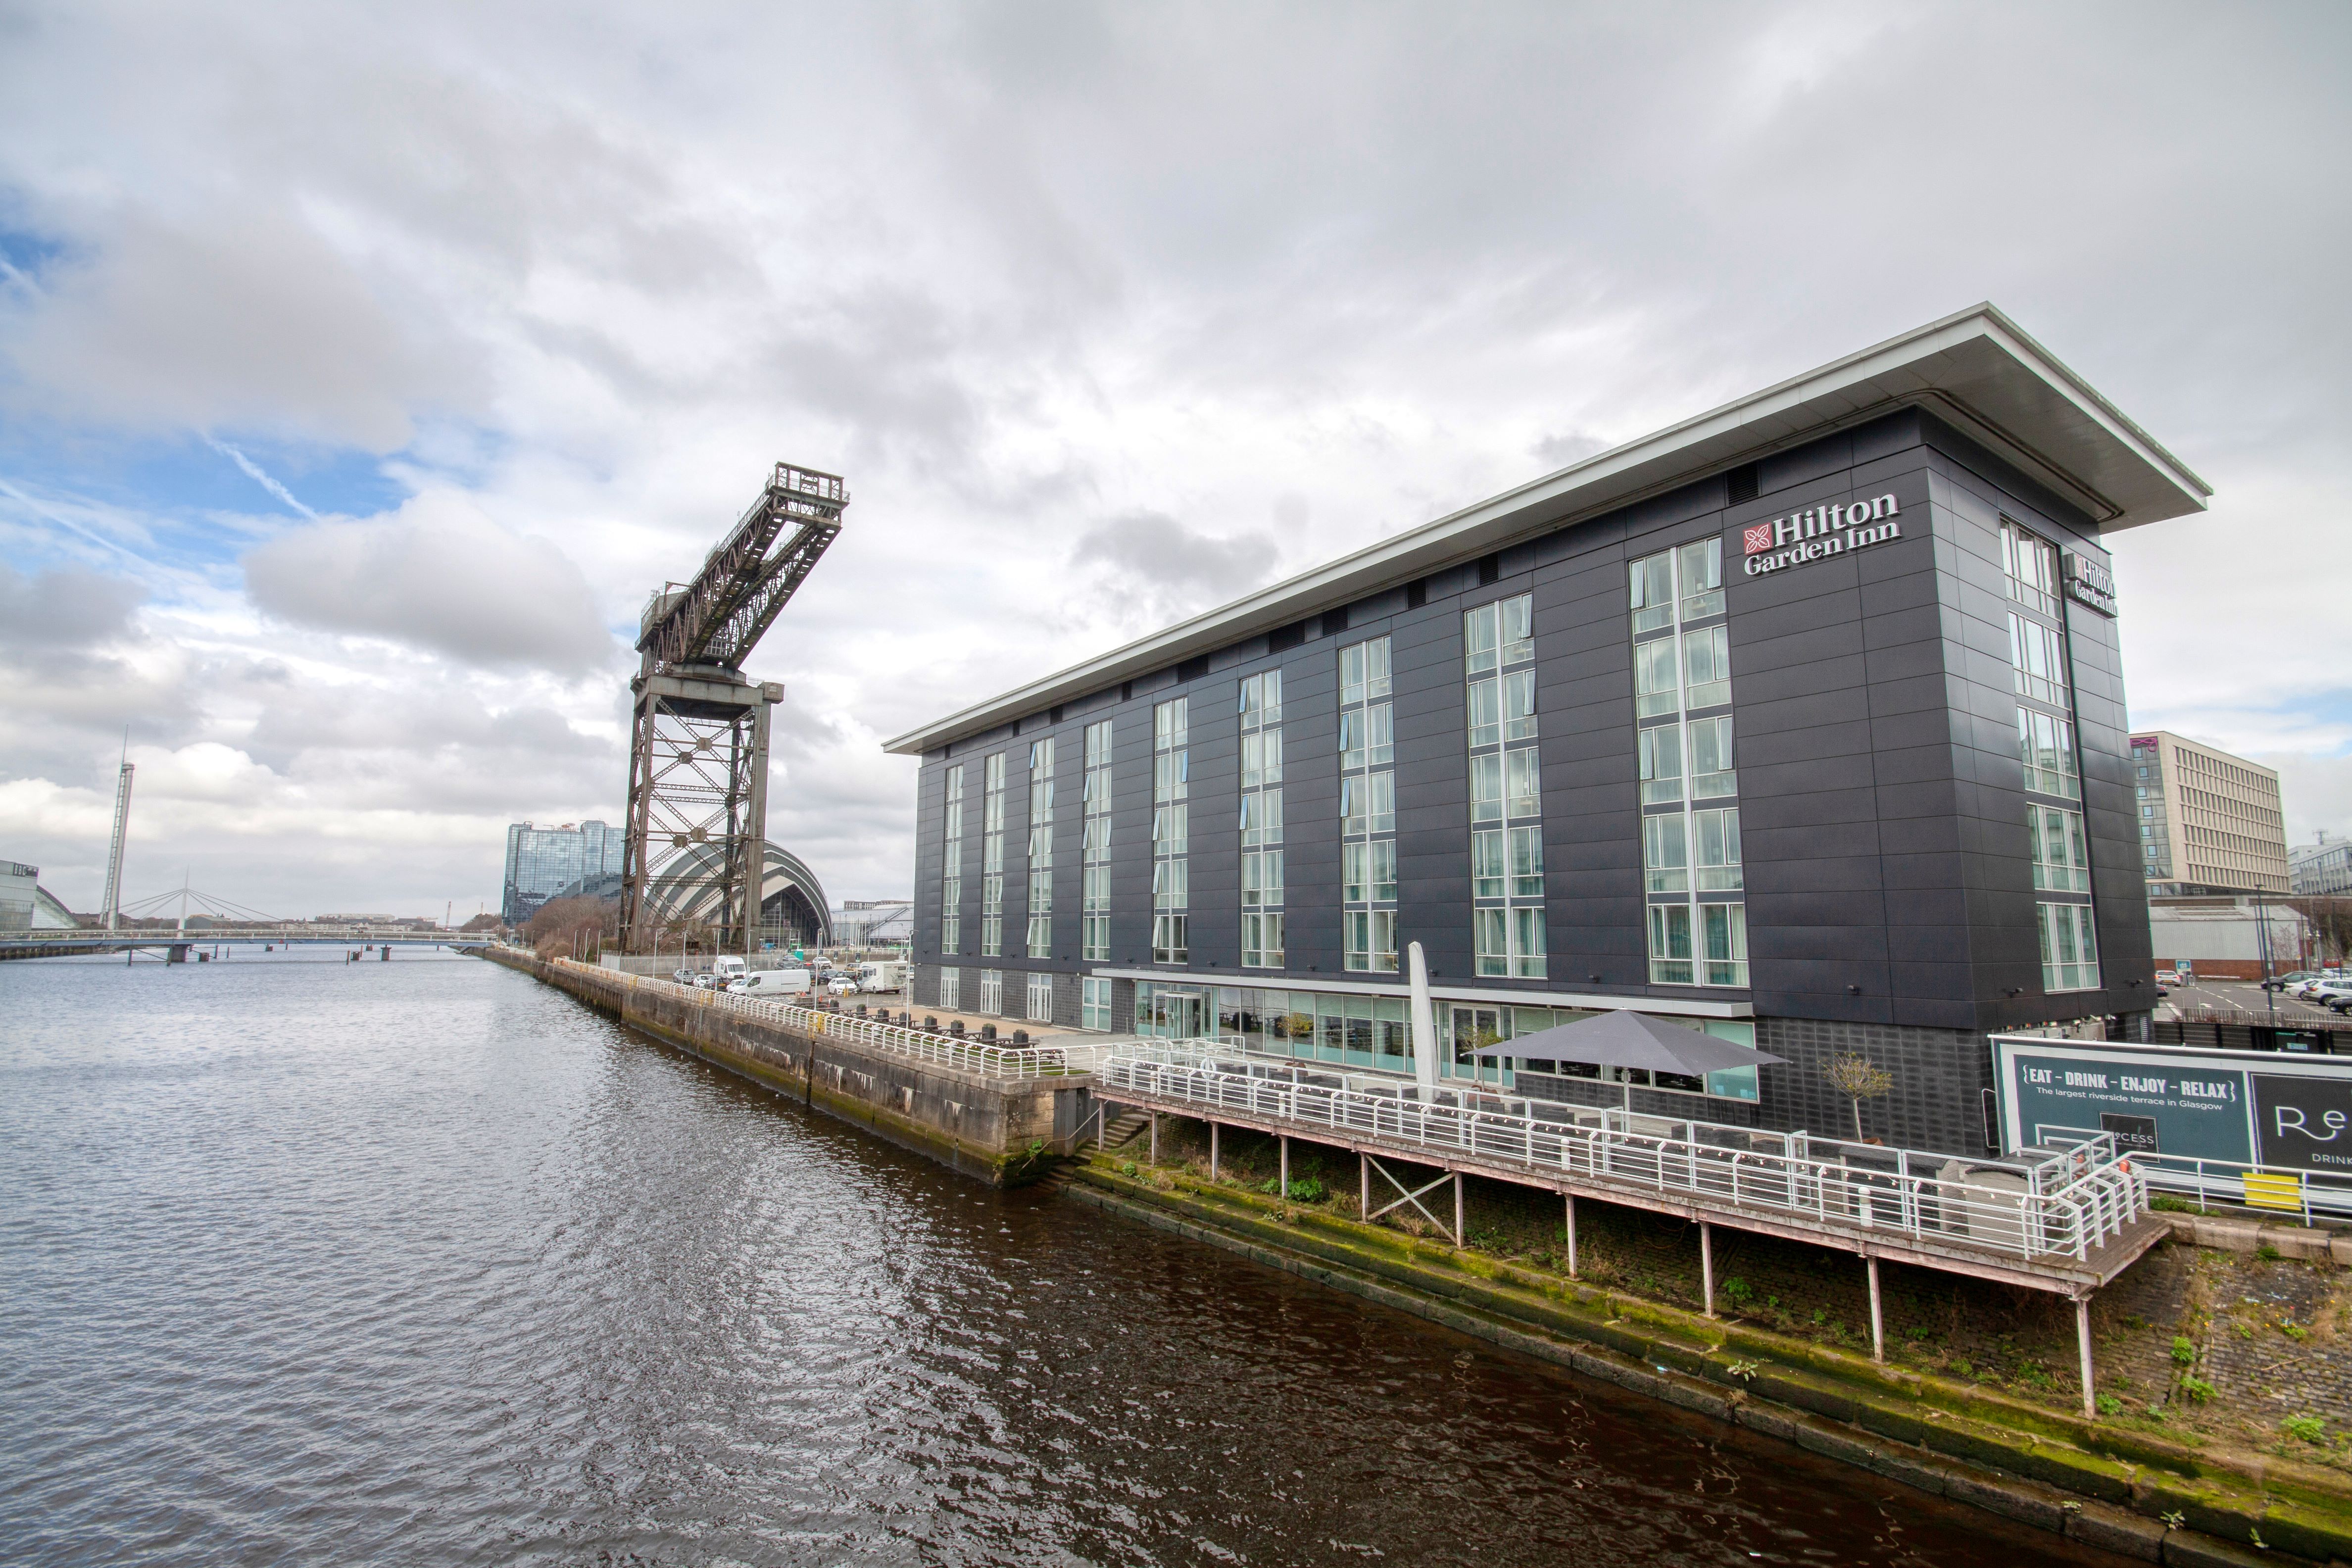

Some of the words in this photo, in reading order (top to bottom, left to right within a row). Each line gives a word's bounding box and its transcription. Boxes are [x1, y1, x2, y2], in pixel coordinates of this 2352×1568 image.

[1773, 494, 1900, 546] Hilton
[1744, 541, 1844, 576] Garden
[1845, 522, 1902, 549] Inn
[2082, 558, 2115, 597] Hilton
[2075, 580, 2106, 610] Garden
[2104, 595, 2117, 616] Inn
[2056, 1089, 2087, 1098] largest
[2089, 1092, 2128, 1102] riverside
[2131, 1096, 2165, 1105] terrace
[2179, 1100, 2222, 1110] Glasgow
[2065, 1072, 2108, 1088] DRINK
[2120, 1076, 2166, 1093] ENJOY
[2114, 1132, 2154, 1144] eCESS
